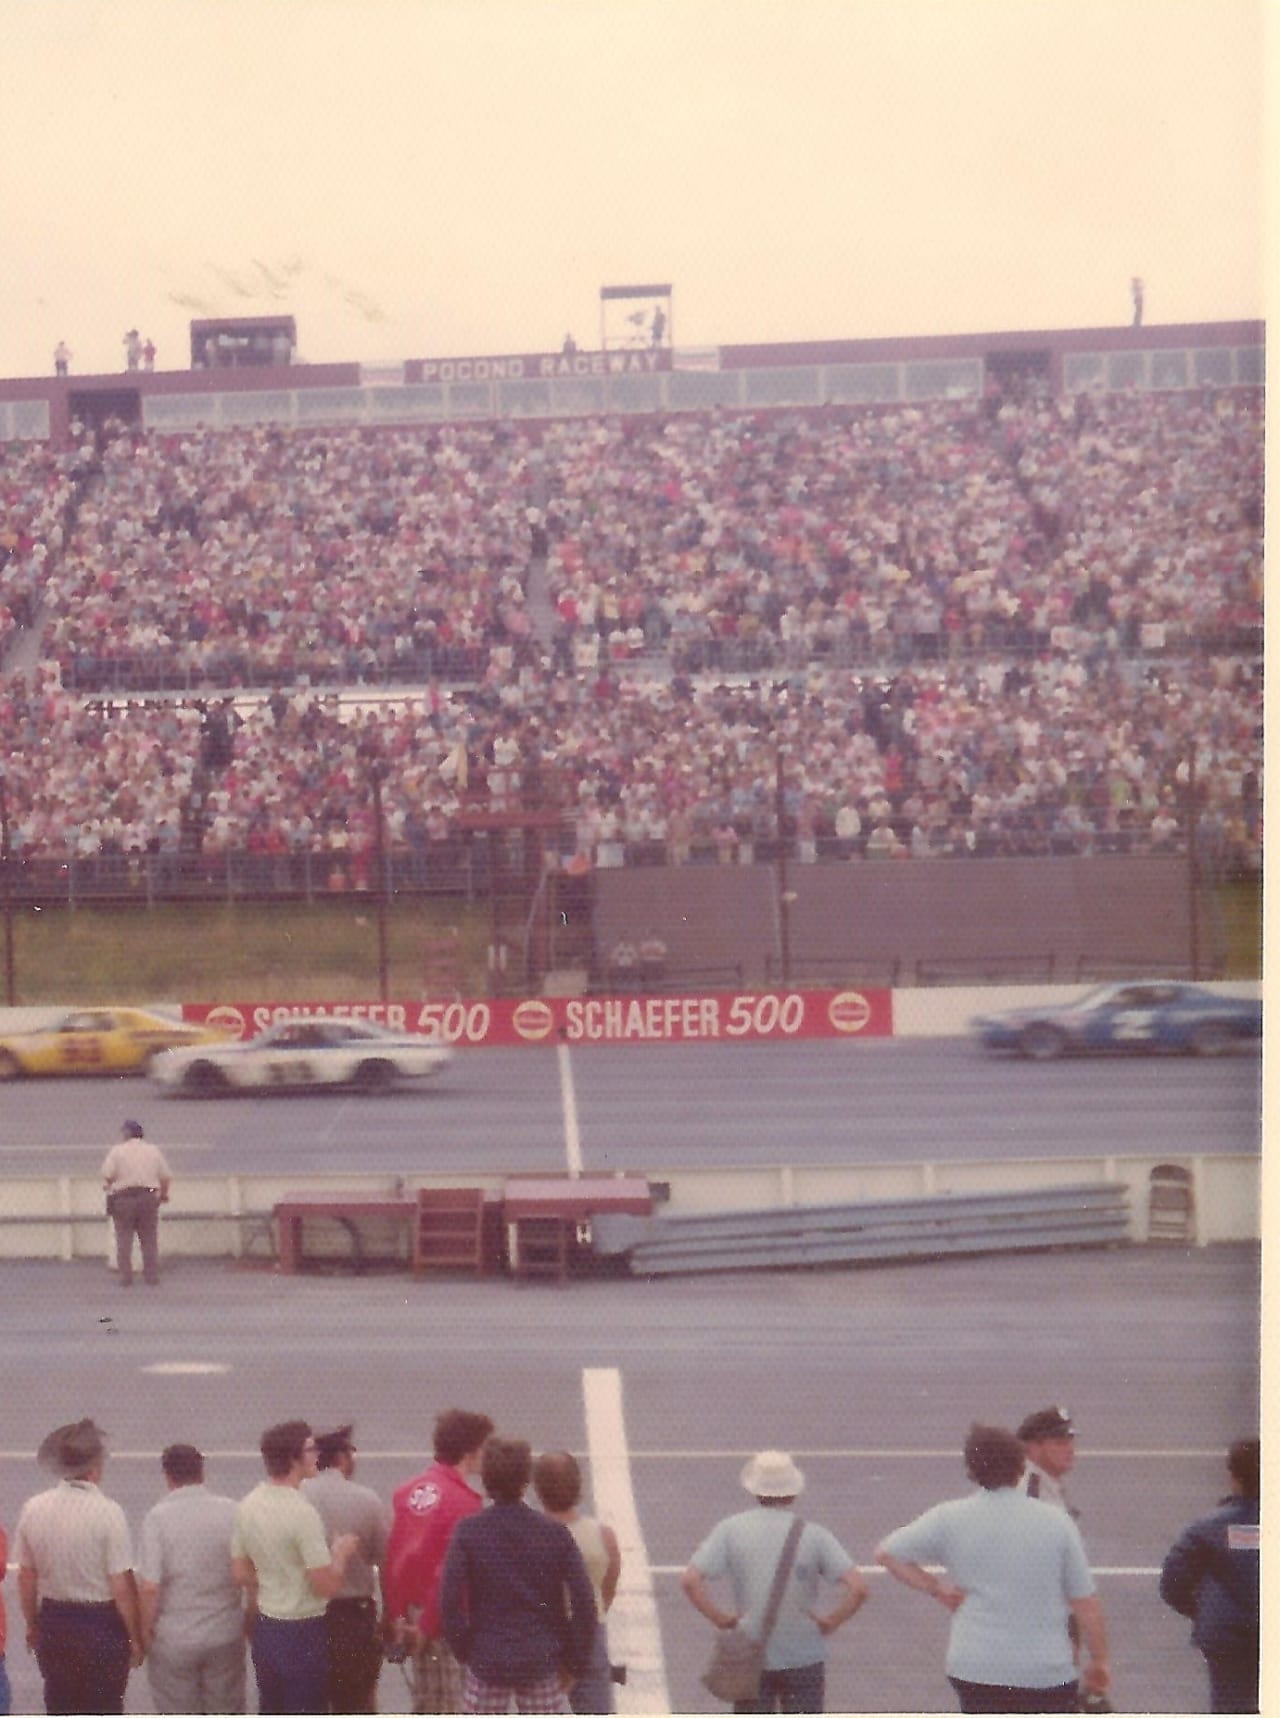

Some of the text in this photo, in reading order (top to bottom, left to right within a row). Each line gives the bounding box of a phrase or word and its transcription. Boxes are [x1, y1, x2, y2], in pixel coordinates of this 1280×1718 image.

[540, 352, 658, 377] RACEWAY
[418, 1003, 491, 1041] 500
[566, 995, 805, 1039] SCHAEFER 500
